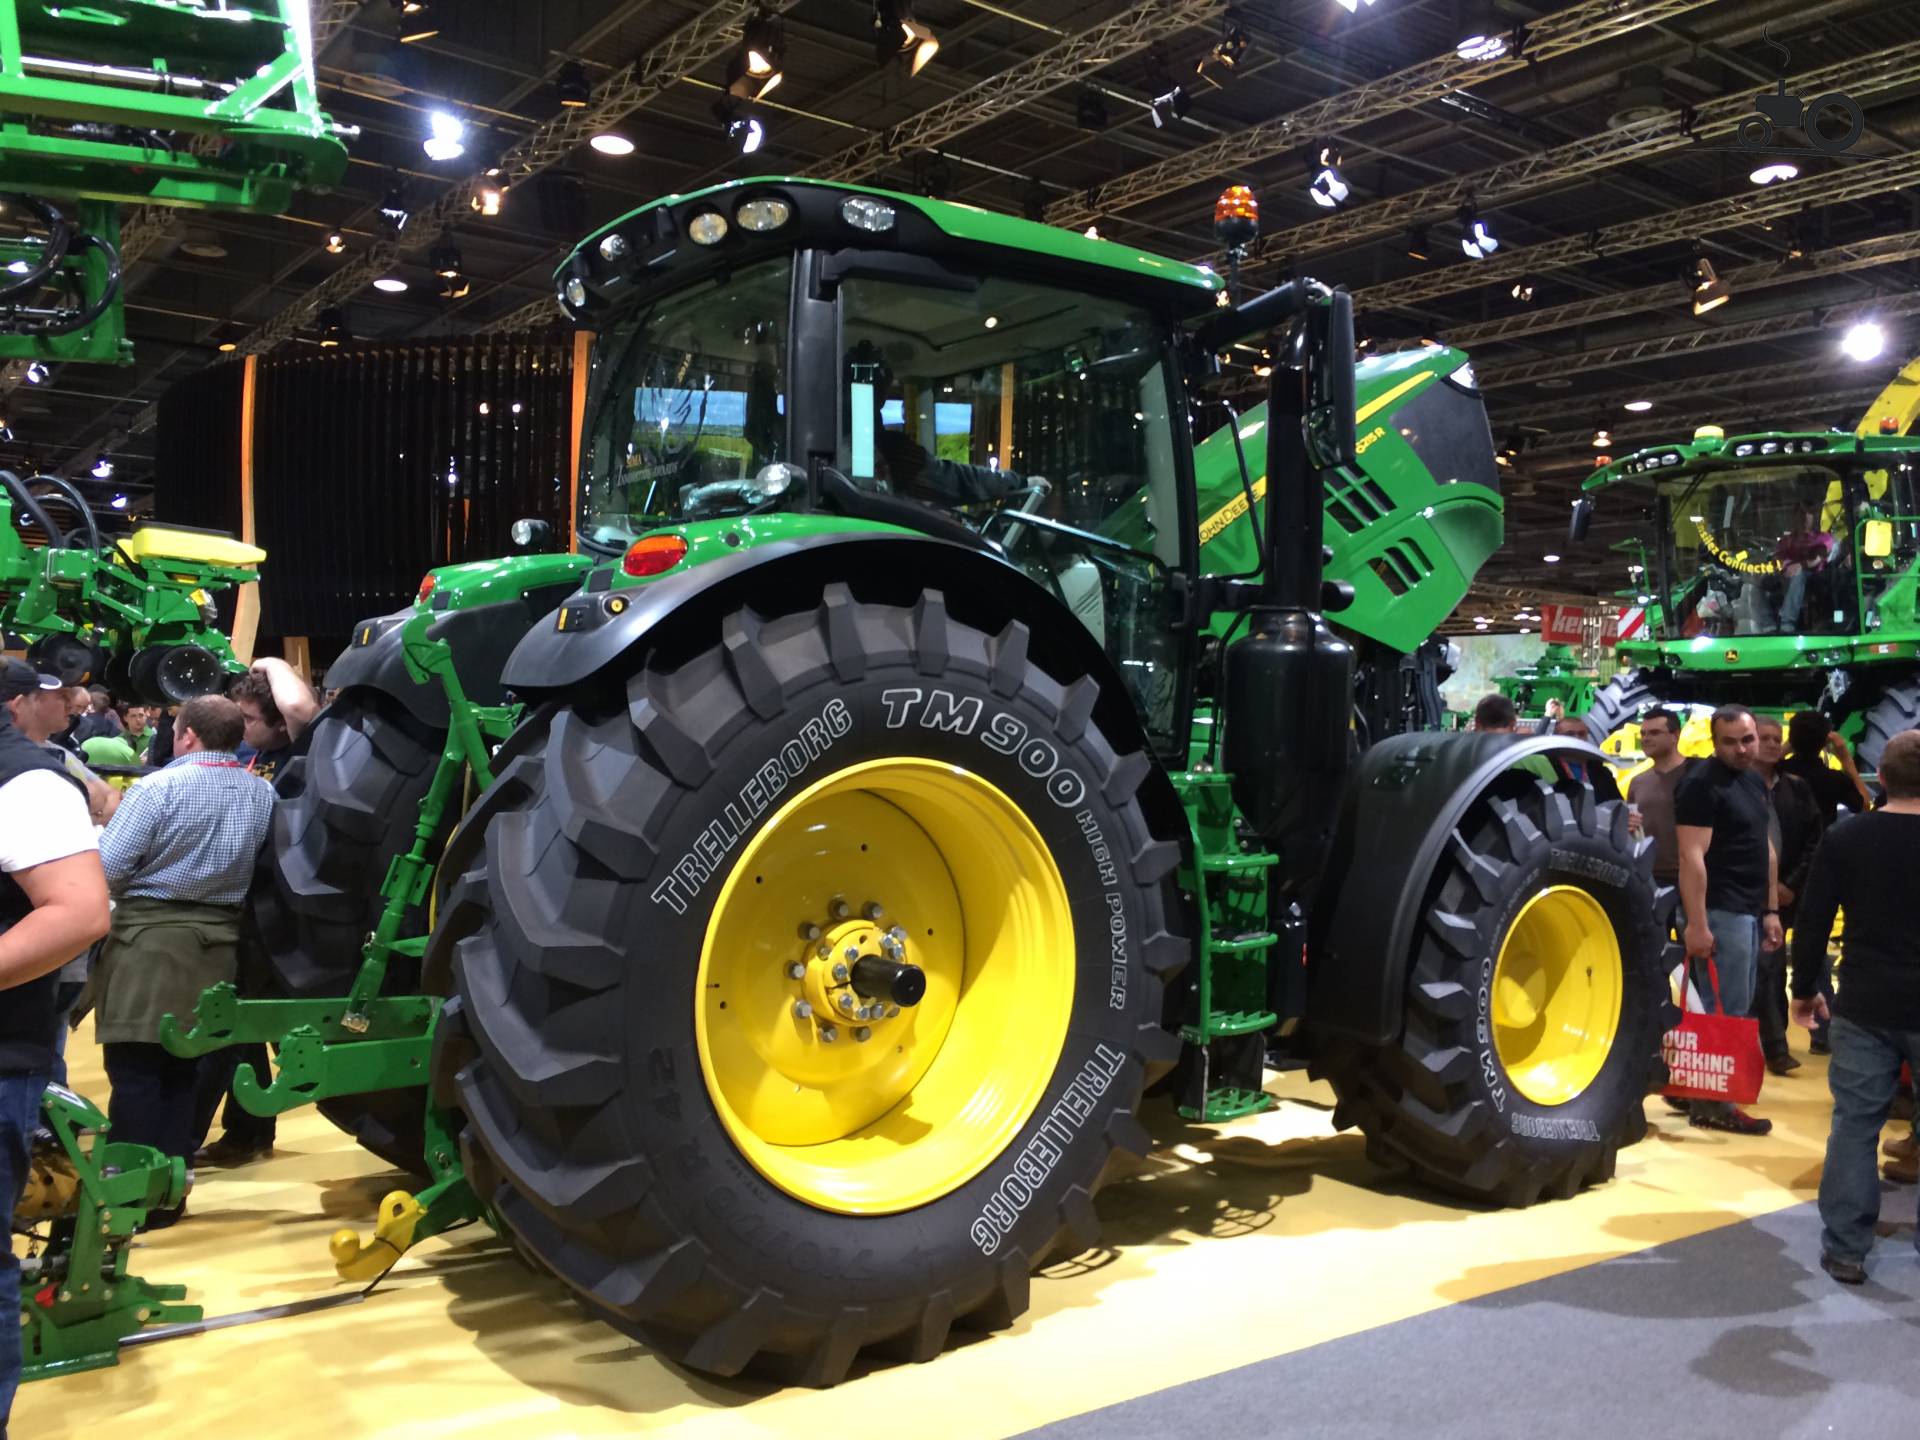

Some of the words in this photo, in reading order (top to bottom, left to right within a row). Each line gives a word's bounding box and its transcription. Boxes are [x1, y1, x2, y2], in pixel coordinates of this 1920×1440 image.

[1199, 520, 1224, 543] OHN
[1222, 489, 1260, 523] DEEE
[1719, 550, 1775, 574] Connecté
[651, 698, 852, 915] TRELLEBORG
[1076, 809, 1118, 886] HIGH
[1105, 892, 1127, 1010] POWER
[1662, 1029, 1698, 1051] OUR
[1668, 1067, 1729, 1092] CHINE
[970, 1042, 1126, 1256] TRELLEBORG
